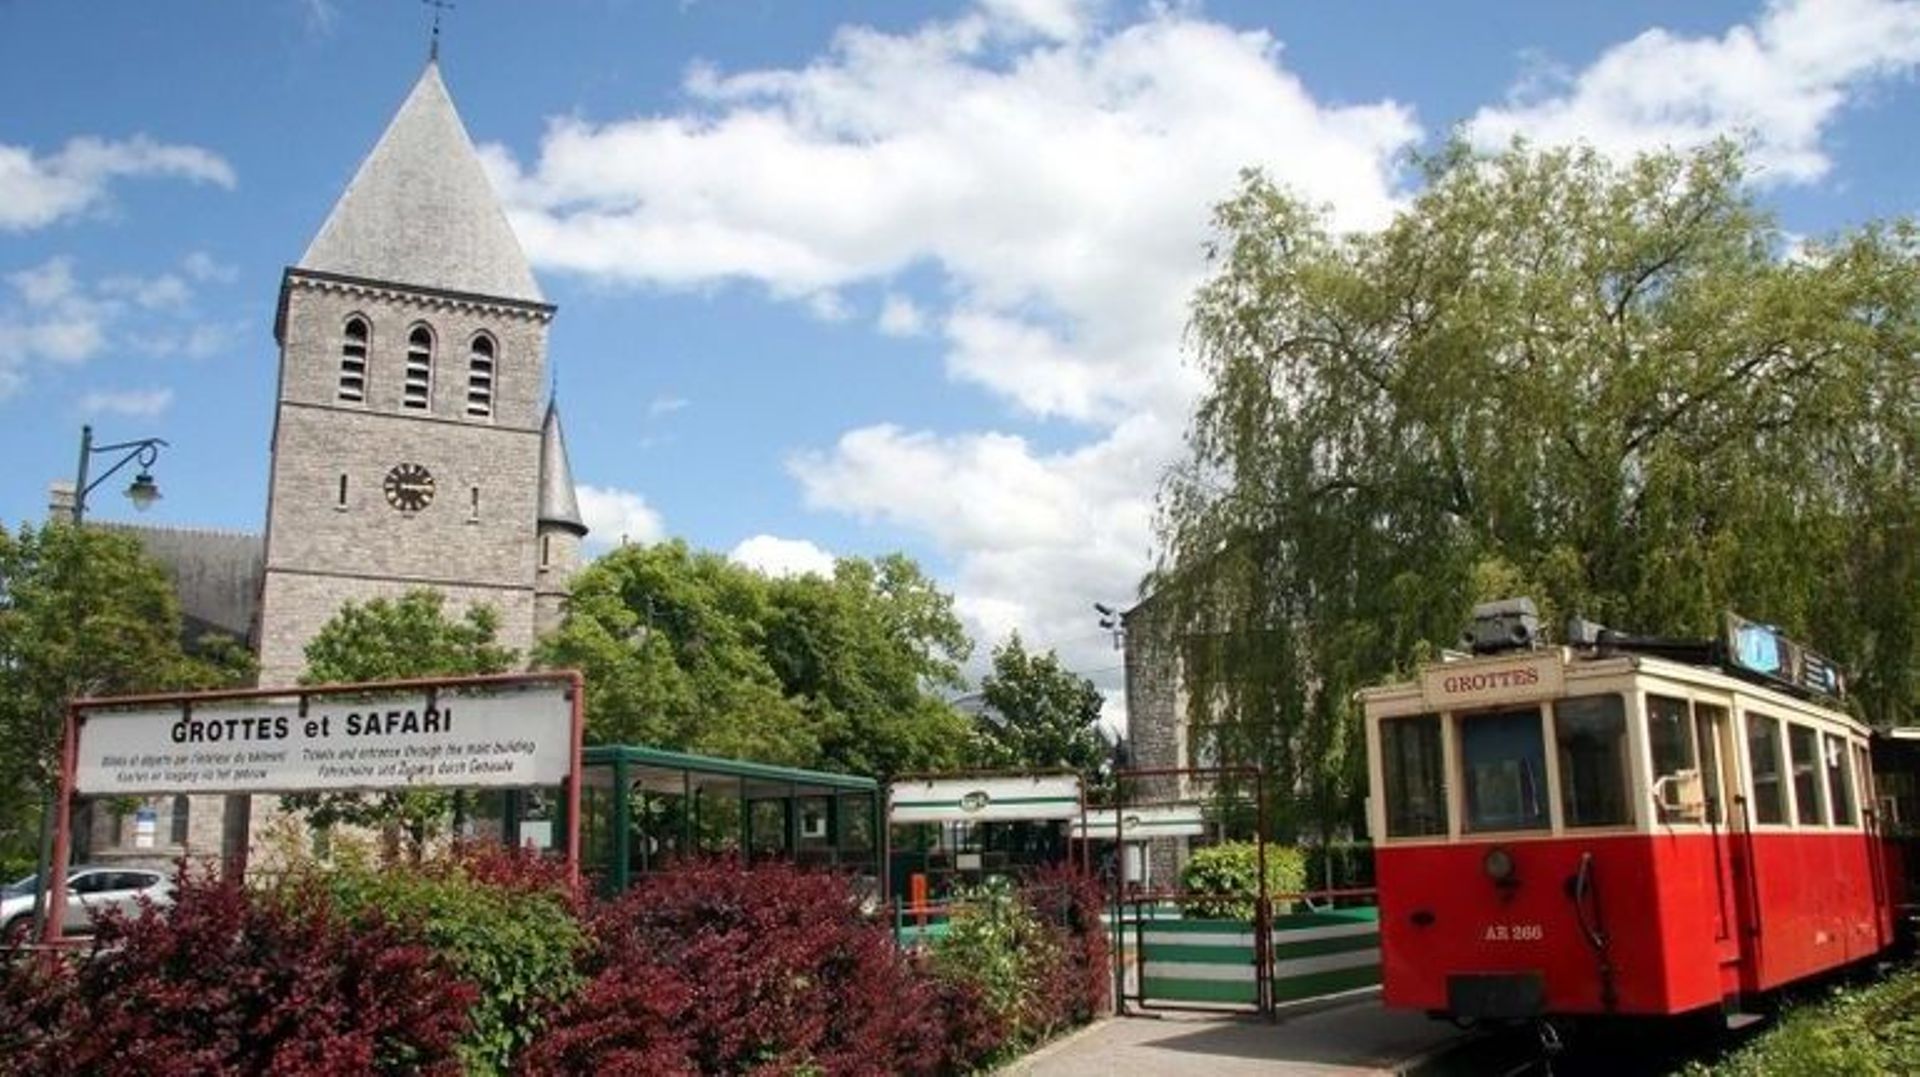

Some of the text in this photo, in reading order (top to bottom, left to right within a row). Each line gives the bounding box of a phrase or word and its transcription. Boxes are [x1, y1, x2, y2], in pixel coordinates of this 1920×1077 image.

[1443, 667, 1539, 693] GROTTES
[171, 709, 451, 743] GROTTES et SAFARI
[447, 744, 462, 755] the
[492, 740, 536, 755] building
[1485, 924, 1543, 940] AR 266
